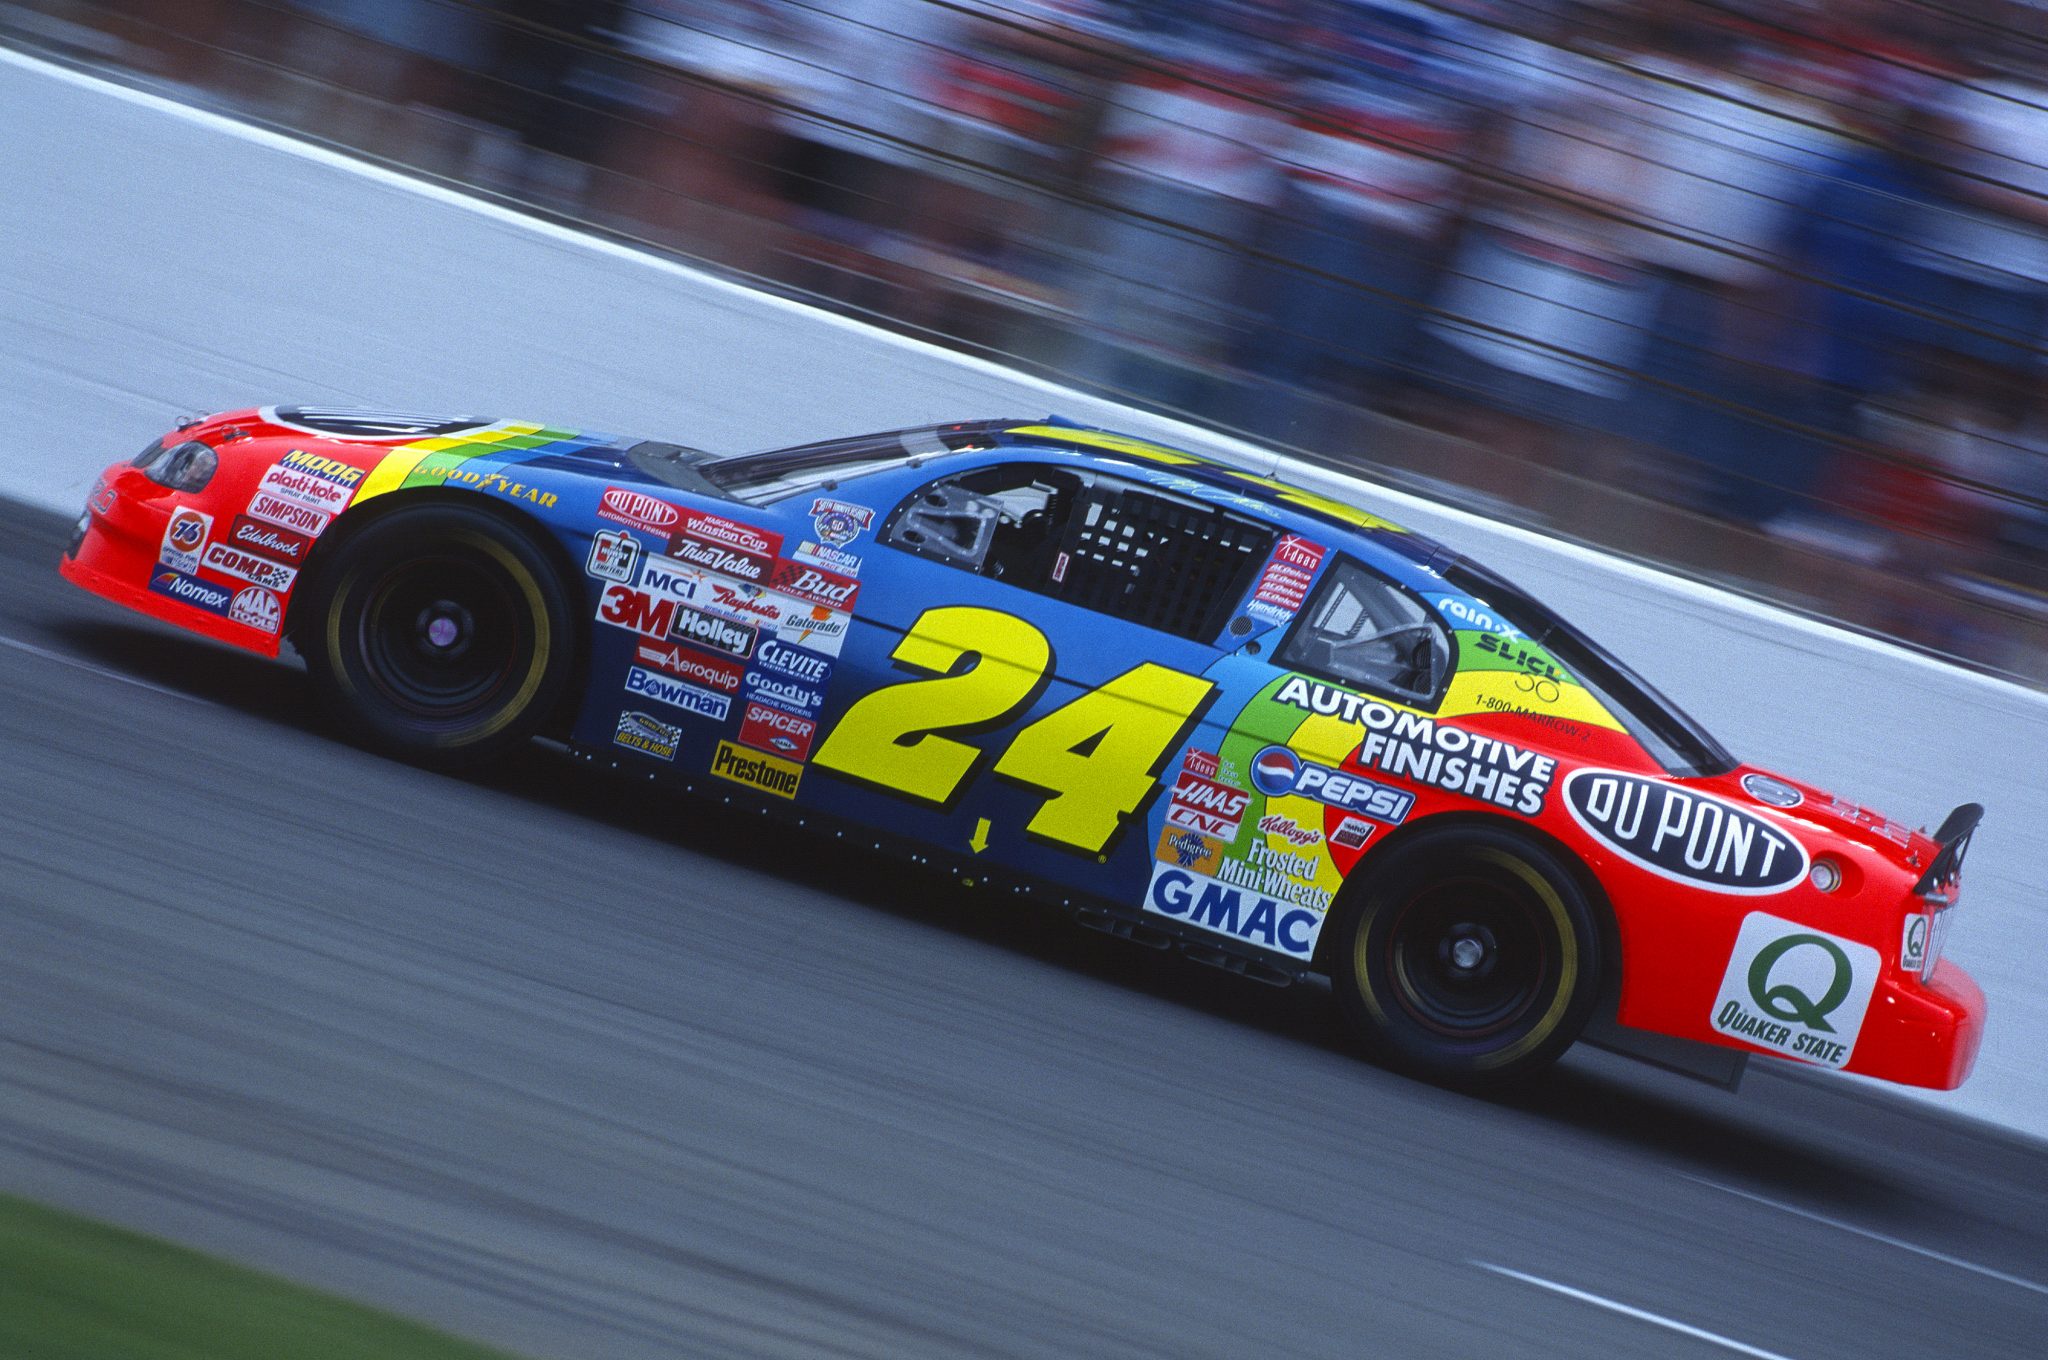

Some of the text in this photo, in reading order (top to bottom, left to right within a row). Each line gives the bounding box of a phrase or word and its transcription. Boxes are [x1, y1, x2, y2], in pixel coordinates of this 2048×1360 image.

[283, 450, 366, 483] MOOG
[267, 471, 342, 502] plasti-kote
[414, 466, 558, 508] GOODYEAR
[254, 497, 322, 532] SIMPSON
[598, 510, 641, 530] AUTOMOTIVE
[172, 519, 202, 545] 76
[237, 525, 300, 556] Edelbrock
[687, 518, 768, 552] Winston Cup
[208, 547, 275, 577] COMP
[816, 546, 858, 567] NASCAR
[1270, 563, 1311, 580] ACDelco
[169, 577, 229, 608] Nomex
[645, 570, 697, 600] MCI
[790, 570, 857, 602] Bud
[1263, 581, 1303, 599] ACDelco
[1266, 572, 1307, 590] ACDelco
[235, 586, 279, 620] MAC
[601, 585, 676, 640] 3M
[1247, 599, 1293, 620] Hendrick
[1259, 591, 1300, 608] ACDelco
[232, 609, 278, 632] TOOLS
[679, 609, 750, 653] Holley
[786, 614, 841, 635] Gatorade
[661, 646, 738, 689] Aeroquip
[757, 640, 828, 678] CLEVITE
[746, 671, 822, 708] Goody's
[747, 707, 812, 738] SPICER
[811, 606, 1215, 853] 24
[1277, 677, 1555, 783] AUTOMOTIVE
[617, 731, 642, 747] BELTS
[714, 745, 798, 794] Prestone
[1360, 732, 1544, 815] FINISHES
[1170, 782, 1253, 817] HAAS
[1295, 766, 1409, 820] PEPSI
[1170, 808, 1236, 837] CNC
[1259, 814, 1322, 846] Kellogg's
[1587, 778, 1648, 840] DU
[1651, 790, 1786, 878] PONT
[1168, 834, 1213, 858] Pedigree
[1248, 839, 1319, 880] Frosted
[1153, 869, 1318, 953] GMAC
[1748, 933, 1853, 1034] Q
[1717, 1000, 1847, 1064] QUAKER STATE
